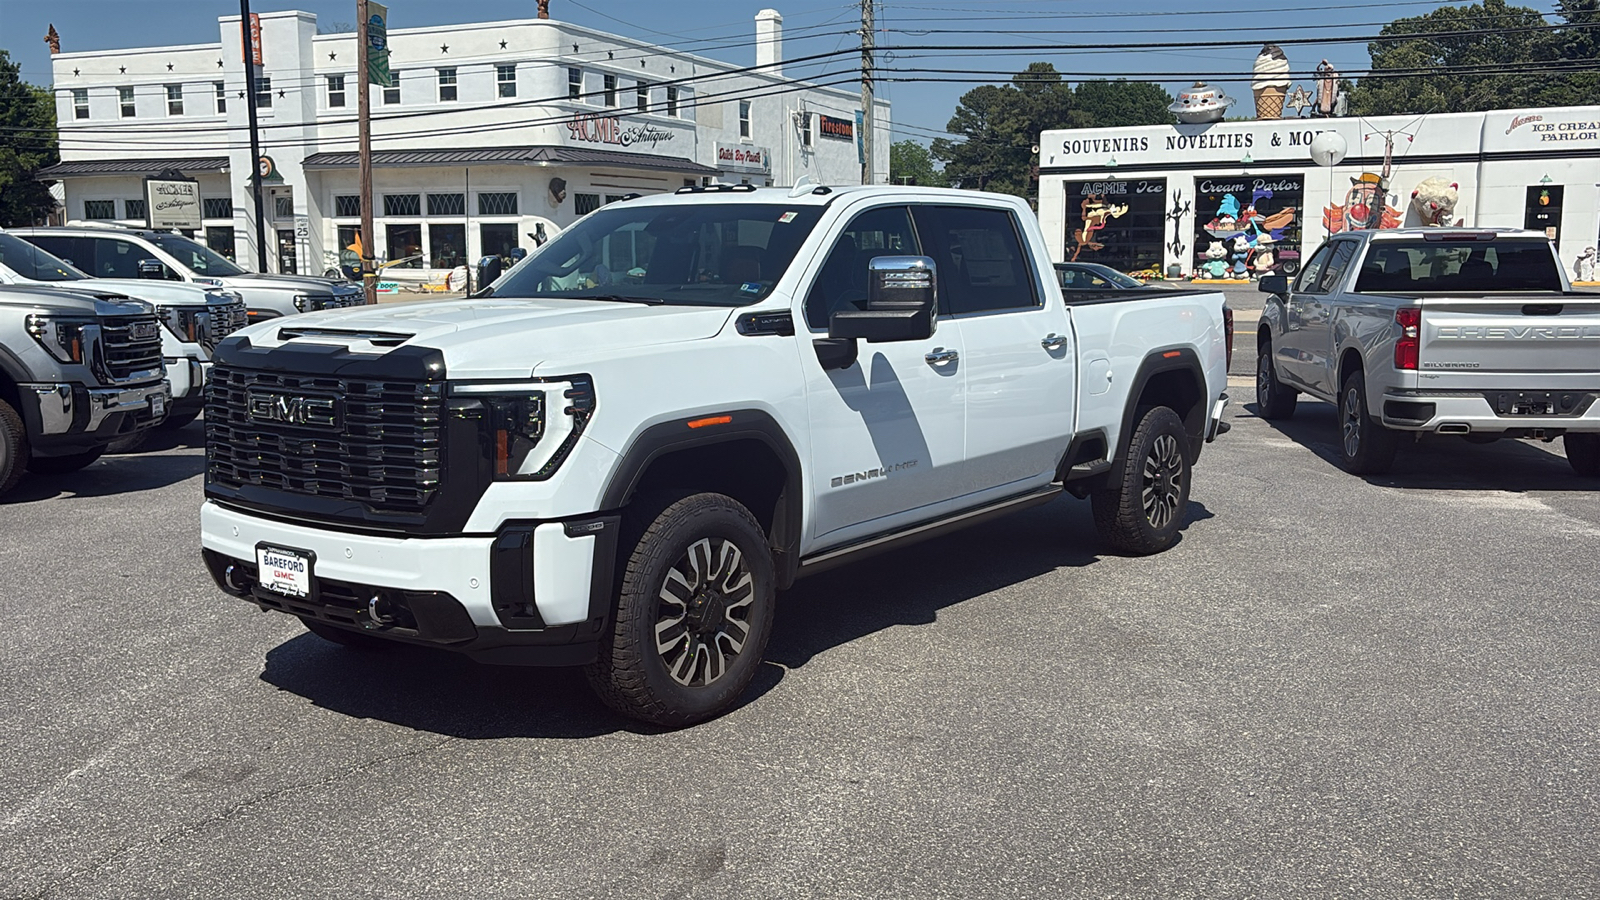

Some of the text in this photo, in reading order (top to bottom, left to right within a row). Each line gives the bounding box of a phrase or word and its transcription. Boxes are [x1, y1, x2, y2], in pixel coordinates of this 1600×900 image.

[567, 111, 620, 145] ACME
[820, 116, 852, 136] Firestone
[1532, 122, 1600, 132] ICE CREA
[1062, 130, 1336, 155] SOUVENIRS NOVELTIES & MO
[1541, 132, 1598, 141] PARLOR
[719, 148, 761, 164] Dutch Boy Paints
[1081, 181, 1164, 195] ACME Ice
[1200, 179, 1300, 193] Cream Parlor
[297, 228, 308, 236] 25
[248, 393, 334, 426] GMC
[830, 464, 893, 488] DENALI
[264, 555, 304, 573] BAREFORD
[274, 570, 295, 581] GMC
